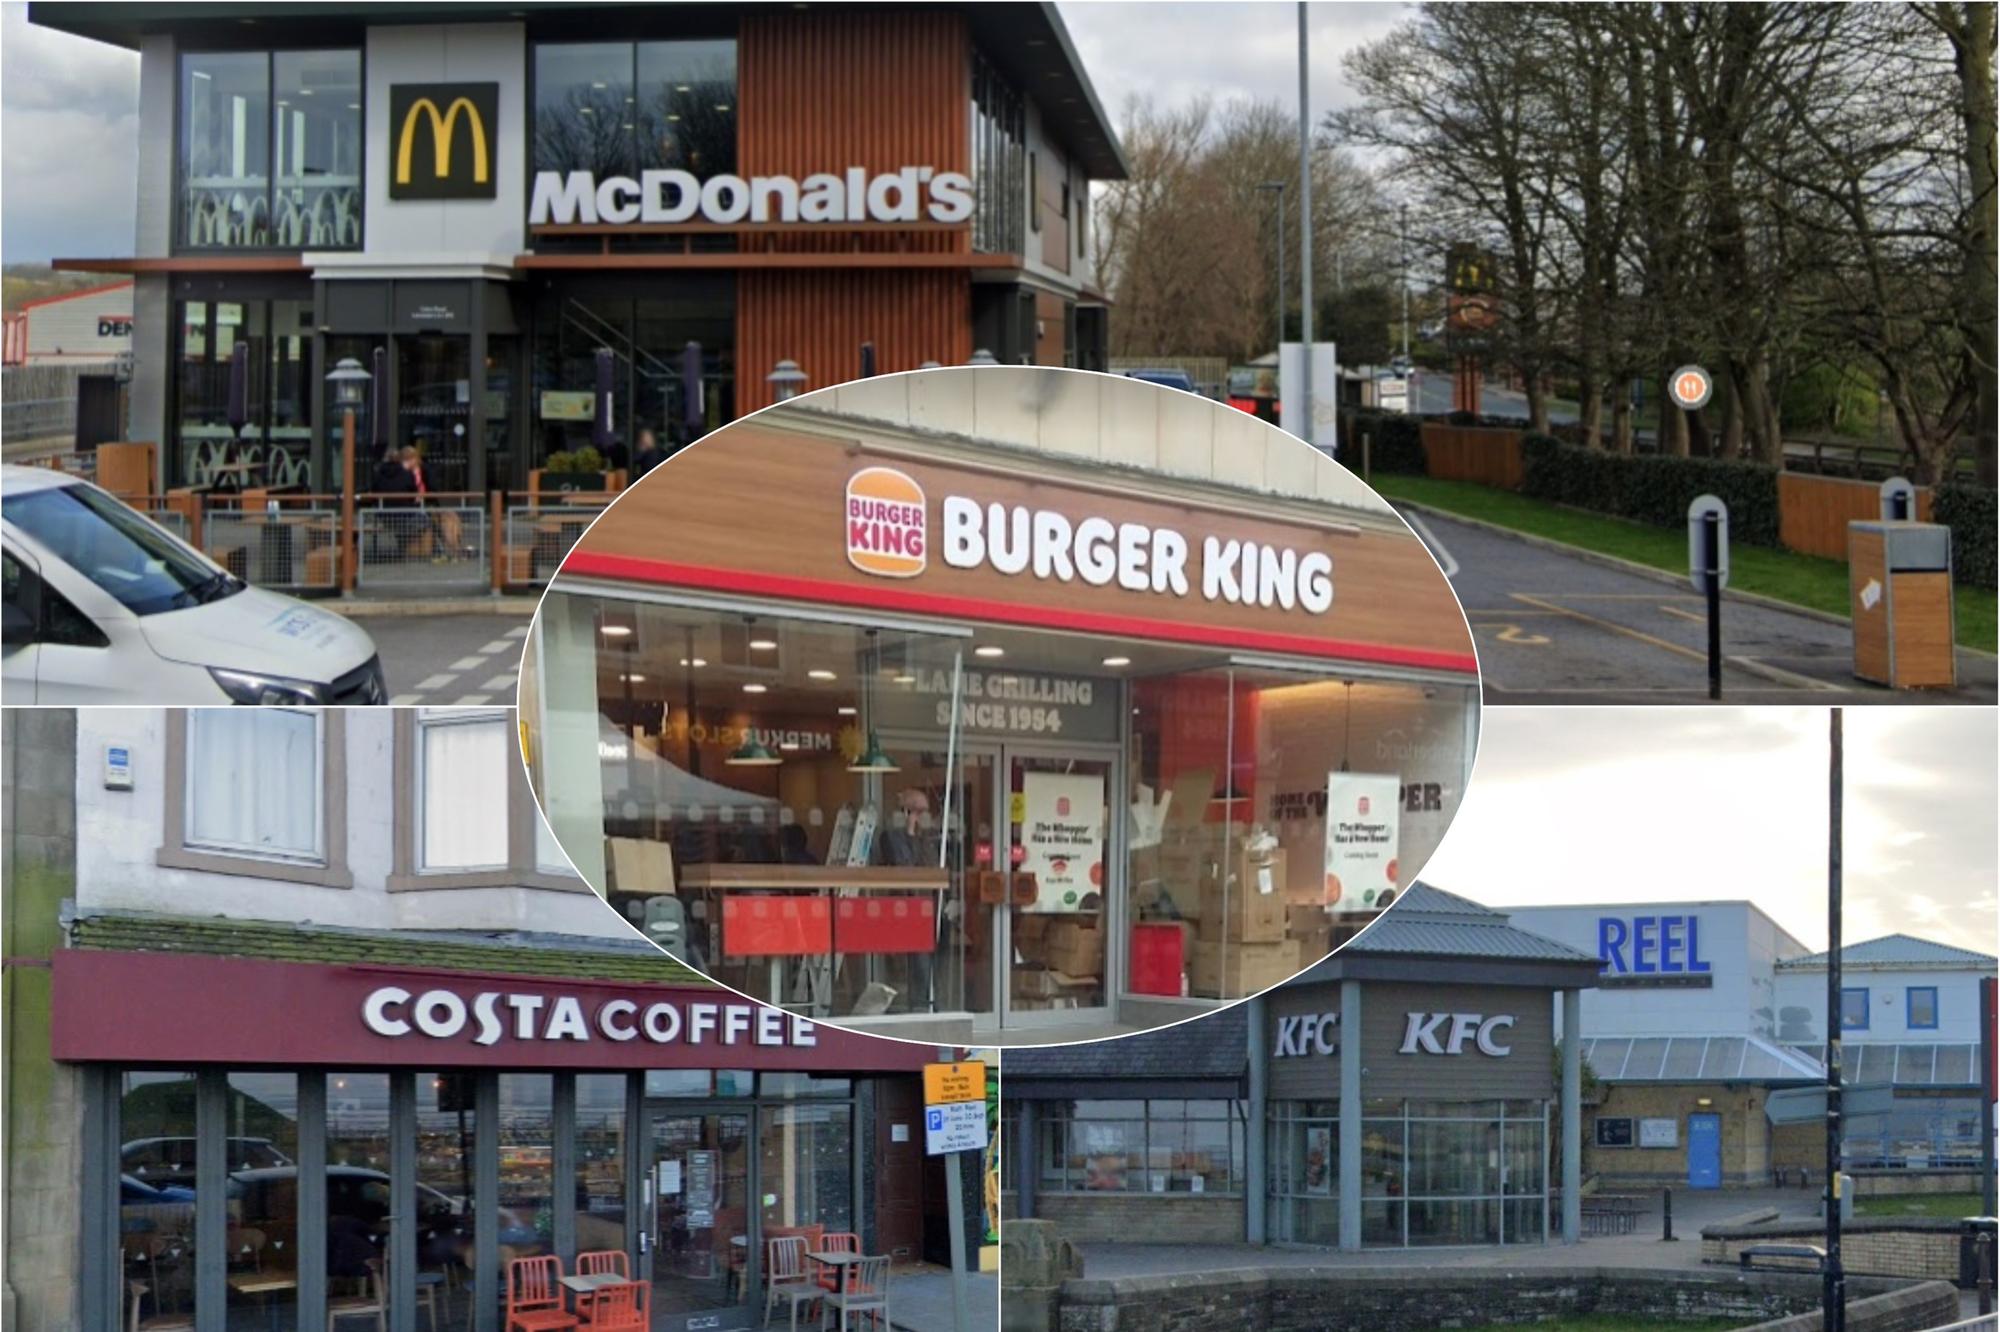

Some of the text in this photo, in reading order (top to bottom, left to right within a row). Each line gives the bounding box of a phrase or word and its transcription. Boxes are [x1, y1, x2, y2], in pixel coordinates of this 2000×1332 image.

[529, 166, 975, 224] McDonald's
[849, 498, 923, 528] BURGER
[850, 520, 924, 557] KING
[943, 495, 1334, 614] BURGER KING
[986, 674, 1093, 706] GRILLING
[936, 702, 1063, 733] SNCE 1954
[1599, 915, 1712, 973] REEL
[362, 986, 817, 1047] COSTA COFFEE
[1273, 1012, 1336, 1057] KFC
[1398, 1012, 1514, 1057] KFC
